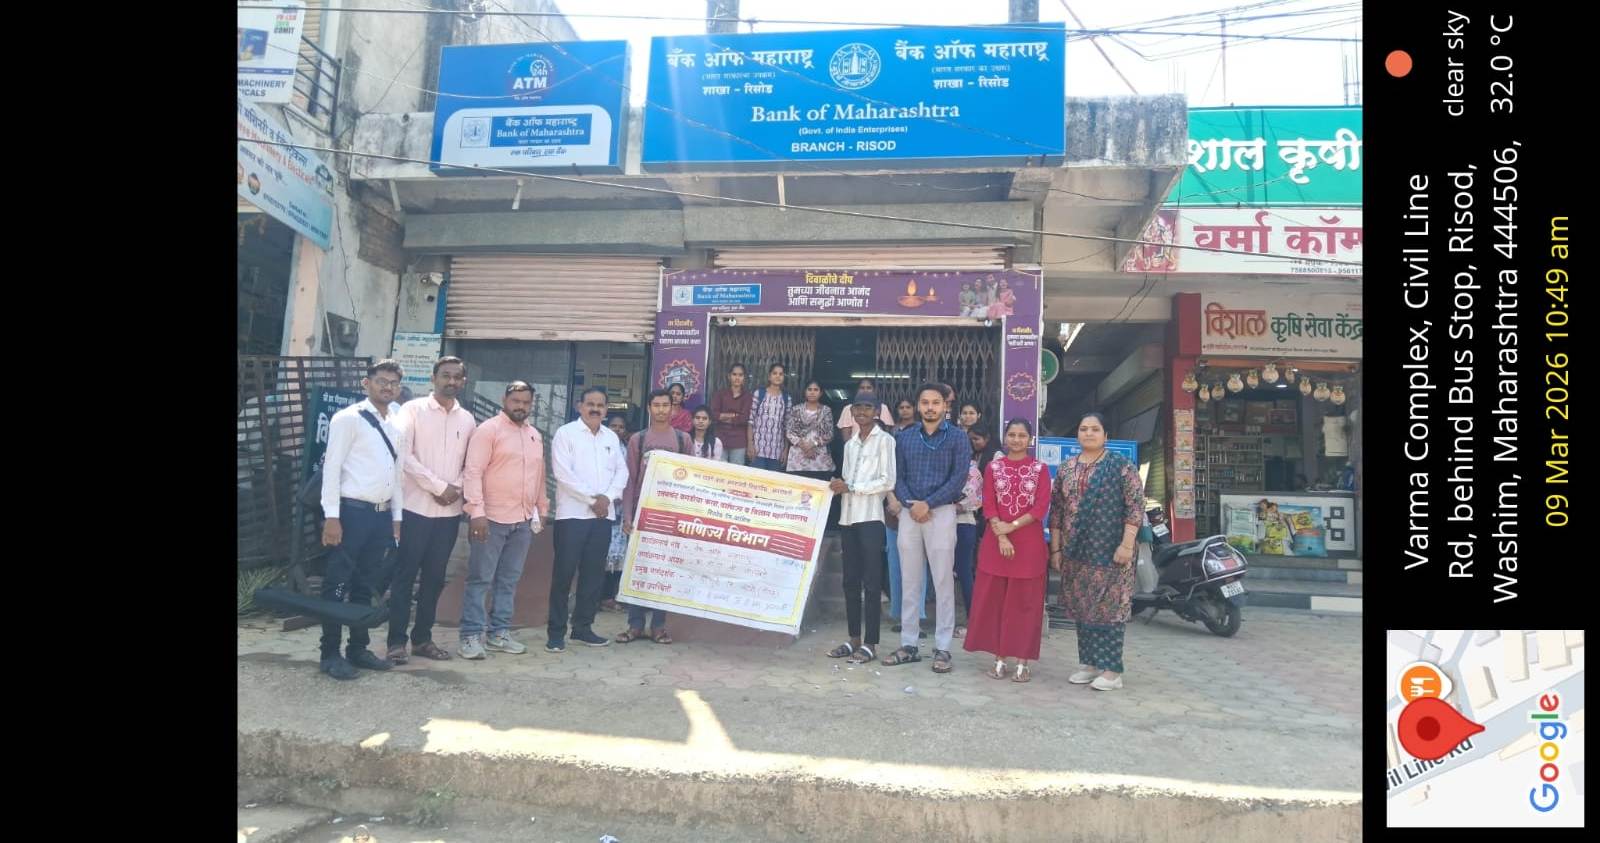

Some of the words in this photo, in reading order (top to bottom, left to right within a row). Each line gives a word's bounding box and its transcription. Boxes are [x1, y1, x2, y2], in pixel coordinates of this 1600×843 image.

[704, 47, 744, 67] ऑफ
[752, 49, 815, 69] महाराष्ट्र
[894, 40, 925, 61] बैंक
[934, 40, 976, 61] ऑफ
[983, 41, 1050, 62] महाराष्ट्र
[513, 77, 547, 90] ATM
[702, 85, 730, 96] शाखा
[744, 81, 774, 95] रिसोड
[933, 78, 964, 90] शाखा
[978, 75, 1010, 88] रिसोड
[751, 105, 801, 122] Bank
[806, 103, 830, 121] of
[833, 101, 960, 120] Maharashtra
[497, 129, 518, 138] Bank
[531, 127, 585, 137] Maharashtra
[799, 127, 823, 136] (Govt.
[825, 127, 834, 135] of
[836, 127, 855, 135] India
[857, 126, 908, 134] Enterprises)
[791, 142, 845, 153] BRANCH
[857, 140, 896, 151] RISOD
[1188, 138, 1266, 172] शाल
[1277, 128, 1362, 183] कृषी
[1193, 211, 1272, 253] वर्मा
[806, 272, 838, 285] दिवाळीचे
[839, 272, 854, 285] दीप
[787, 286, 813, 297] तुमच्या
[815, 284, 845, 296] जीवनात
[847, 285, 871, 296] आनंद
[788, 296, 808, 306] आणि
[1204, 302, 1267, 339] विशाल
[1271, 313, 1304, 343] कृषि
[1305, 313, 1333, 338] सेवा
[676, 517, 725, 540] वाणिज्य
[727, 524, 770, 547] विभाग
